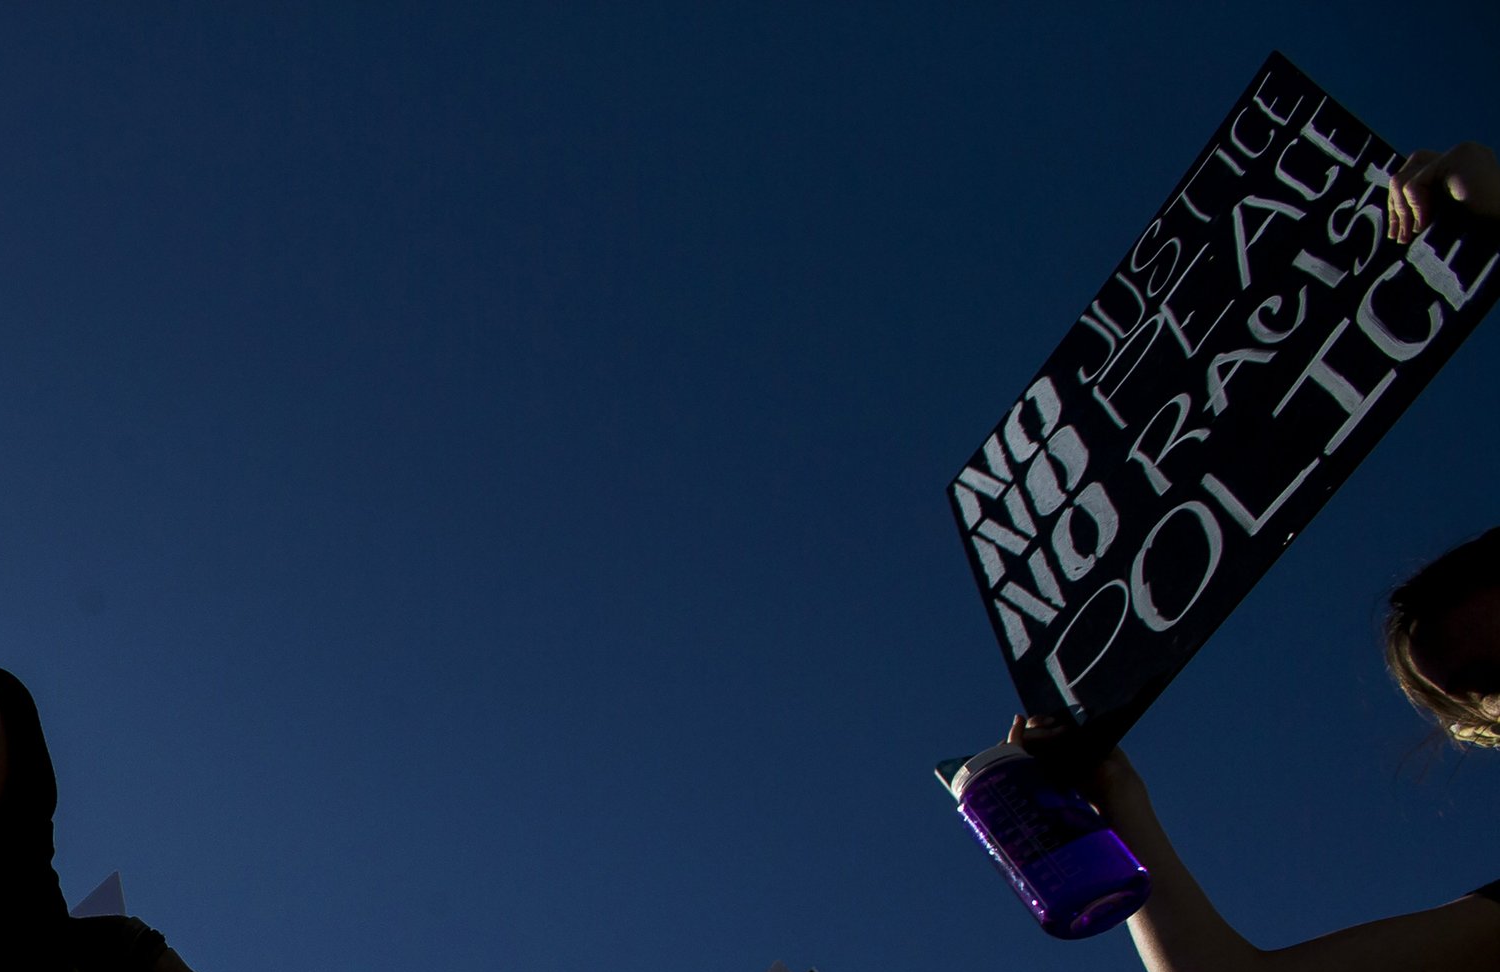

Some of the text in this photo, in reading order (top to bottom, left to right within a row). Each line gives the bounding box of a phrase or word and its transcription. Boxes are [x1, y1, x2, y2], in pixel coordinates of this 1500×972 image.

[954, 71, 1302, 530] NO JUSTICE
[969, 426, 1089, 589] NO
[1092, 96, 1372, 430] PEACE
[994, 481, 1120, 661] NO
[1127, 152, 1398, 497] RACIST
[1045, 222, 1500, 724] POLICE
